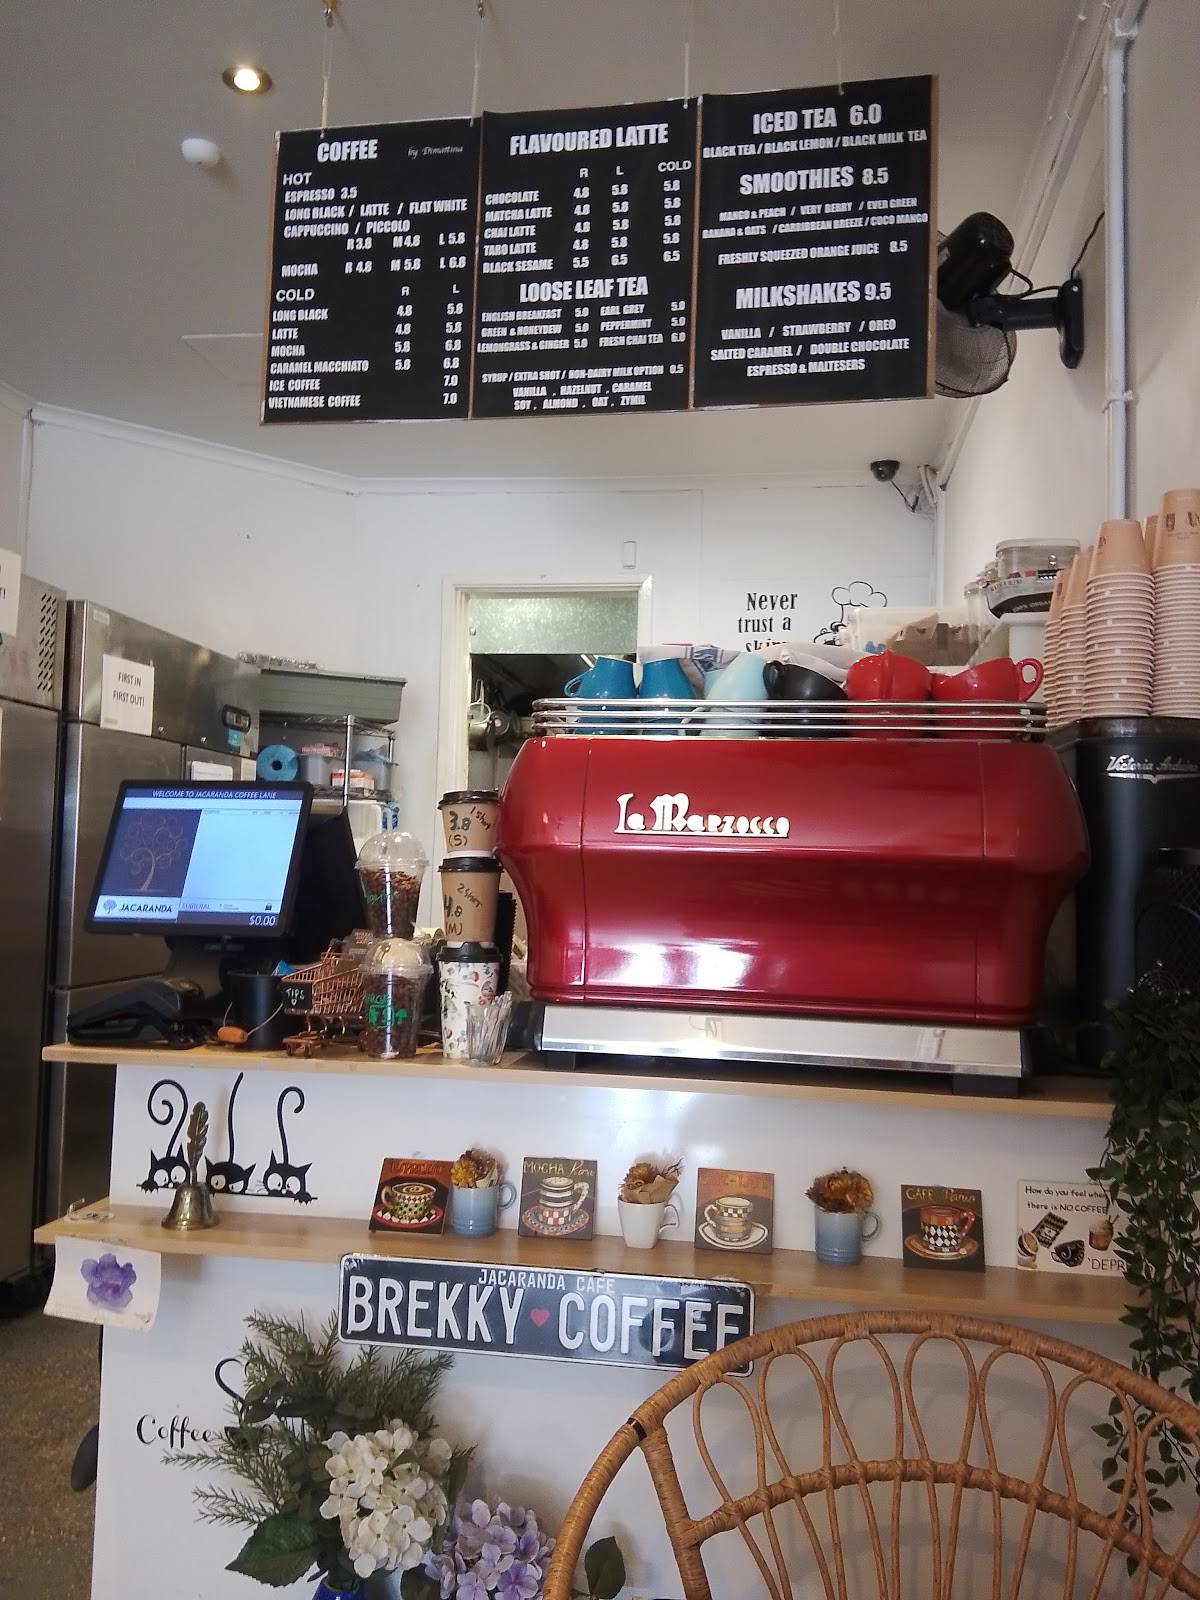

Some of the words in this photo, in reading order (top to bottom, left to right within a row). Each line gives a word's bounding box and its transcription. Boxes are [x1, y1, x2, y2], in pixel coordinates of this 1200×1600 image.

[753, 110, 798, 134] ICED
[801, 107, 837, 129] TEA
[850, 104, 882, 126] 6.0
[510, 128, 612, 156] FLAVOURED
[616, 123, 669, 148] LATTE
[703, 145, 736, 158] BLACK
[737, 144, 756, 156] TEA
[764, 141, 798, 154] BLACK
[799, 137, 833, 151] LEMON
[842, 134, 876, 147] BLACK
[878, 131, 904, 144] MILK
[908, 129, 927, 141] TEA
[317, 139, 378, 163] COFFEE
[580, 168, 588, 178] R
[616, 166, 624, 176] L
[658, 160, 692, 172] COLD
[283, 172, 312, 185] HOT
[740, 166, 854, 195] SMOOTHIES
[862, 167, 889, 185] 8.5
[285, 188, 335, 203] ESPRESSO
[341, 187, 358, 200] 3.5
[485, 190, 540, 206] CHOCOLATE
[573, 187, 589, 199] 4.8
[664, 180, 680, 191] 5.8
[285, 208, 310, 221] LONG
[312, 205, 345, 220] BLACK
[360, 203, 389, 216] LATTE
[409, 201, 431, 214] FLAT
[434, 199, 467, 212] WHITE
[485, 208, 523, 222] MATCHA
[525, 207, 552, 219] LATTE
[800, 204, 822, 215] VERY
[284, 223, 349, 238] CAPPUCCINO
[366, 220, 410, 233] PICCOLO
[484, 227, 508, 239] CHAI
[509, 225, 536, 237] LATTE
[718, 251, 758, 265] FRESHLY
[760, 248, 808, 263] SQUEEZED
[809, 245, 850, 258] ORANGE
[851, 243, 879, 256] JUICE
[889, 240, 908, 252] 8.5
[282, 263, 318, 277] MOCHA
[356, 261, 372, 273] 4.8
[404, 258, 421, 270] 5.8
[440, 257, 446, 268] L
[449, 256, 466, 268] 6.8
[483, 260, 514, 274] BLACK
[515, 259, 554, 272] SESAME
[573, 257, 589, 269] 5.5
[611, 254, 628, 266] 6.5
[276, 289, 315, 302] COLD
[402, 287, 410, 296] R
[453, 284, 459, 294] L
[520, 281, 572, 303] LOOSE
[575, 278, 614, 300] LEAF
[617, 276, 648, 297] TEA
[735, 280, 861, 309] MILKSHAKES
[864, 282, 891, 301] 9.5
[272, 310, 296, 322] LONG
[298, 309, 328, 320] BLACK
[397, 305, 412, 317] 4.8
[447, 303, 464, 315] 5.8
[272, 328, 298, 340] LATTE
[395, 324, 411, 335] 4.8
[446, 322, 462, 333] 5.8
[721, 327, 761, 340] VANILLA
[782, 322, 851, 337] STRAWBERRY
[868, 319, 896, 331] OREO
[271, 345, 305, 357] MOCHA
[395, 341, 411, 353] 5.8
[711, 348, 745, 360] SALTED
[747, 346, 793, 359] CARAMEL
[810, 341, 849, 355] DOUBLE
[851, 338, 910, 353] CHOCOLATE
[270, 362, 312, 375] CARAMEL
[314, 360, 369, 373] MACCHIATO
[395, 359, 411, 370] 5.8
[747, 363, 797, 376] ESPRESSO
[808, 359, 865, 373] MALTESERS
[269, 380, 285, 391] ICE
[288, 378, 320, 391] COFFEE
[269, 396, 325, 409] VIETNAMESE
[328, 395, 361, 408] COFFEE
[746, 592, 798, 611] Never
[738, 617, 773, 633] trust
[782, 617, 791, 631] a
[118, 671, 134, 684] FIRST
[135, 676, 141, 687] IN
[113, 690, 129, 703] FIRST
[129, 693, 145, 707] OUT!
[152, 790, 185, 798] WELCOME
[449, 811, 471, 831] 3.8
[614, 793, 646, 832] La
[650, 793, 790, 836] Marzocco
[119, 904, 172, 913] JACARANDA
[249, 915, 276, 926] $0.00
[286, 988, 304, 999] TIPS
[524, 1161, 565, 1175] MOCHA
[1025, 1186, 1041, 1195] How
[1045, 1187, 1052, 1195] do
[1071, 1188, 1087, 1197] feel
[1028, 1203, 1048, 1211] there
[1060, 1204, 1073, 1212] NO
[1075, 1205, 1109, 1215] COFFEE
[478, 1269, 566, 1291] JACARANDA
[576, 1277, 616, 1295] CAFE
[346, 1275, 525, 1345] BREKKY
[558, 1292, 745, 1360] COFFEE
[136, 1414, 216, 1449] Coffee
